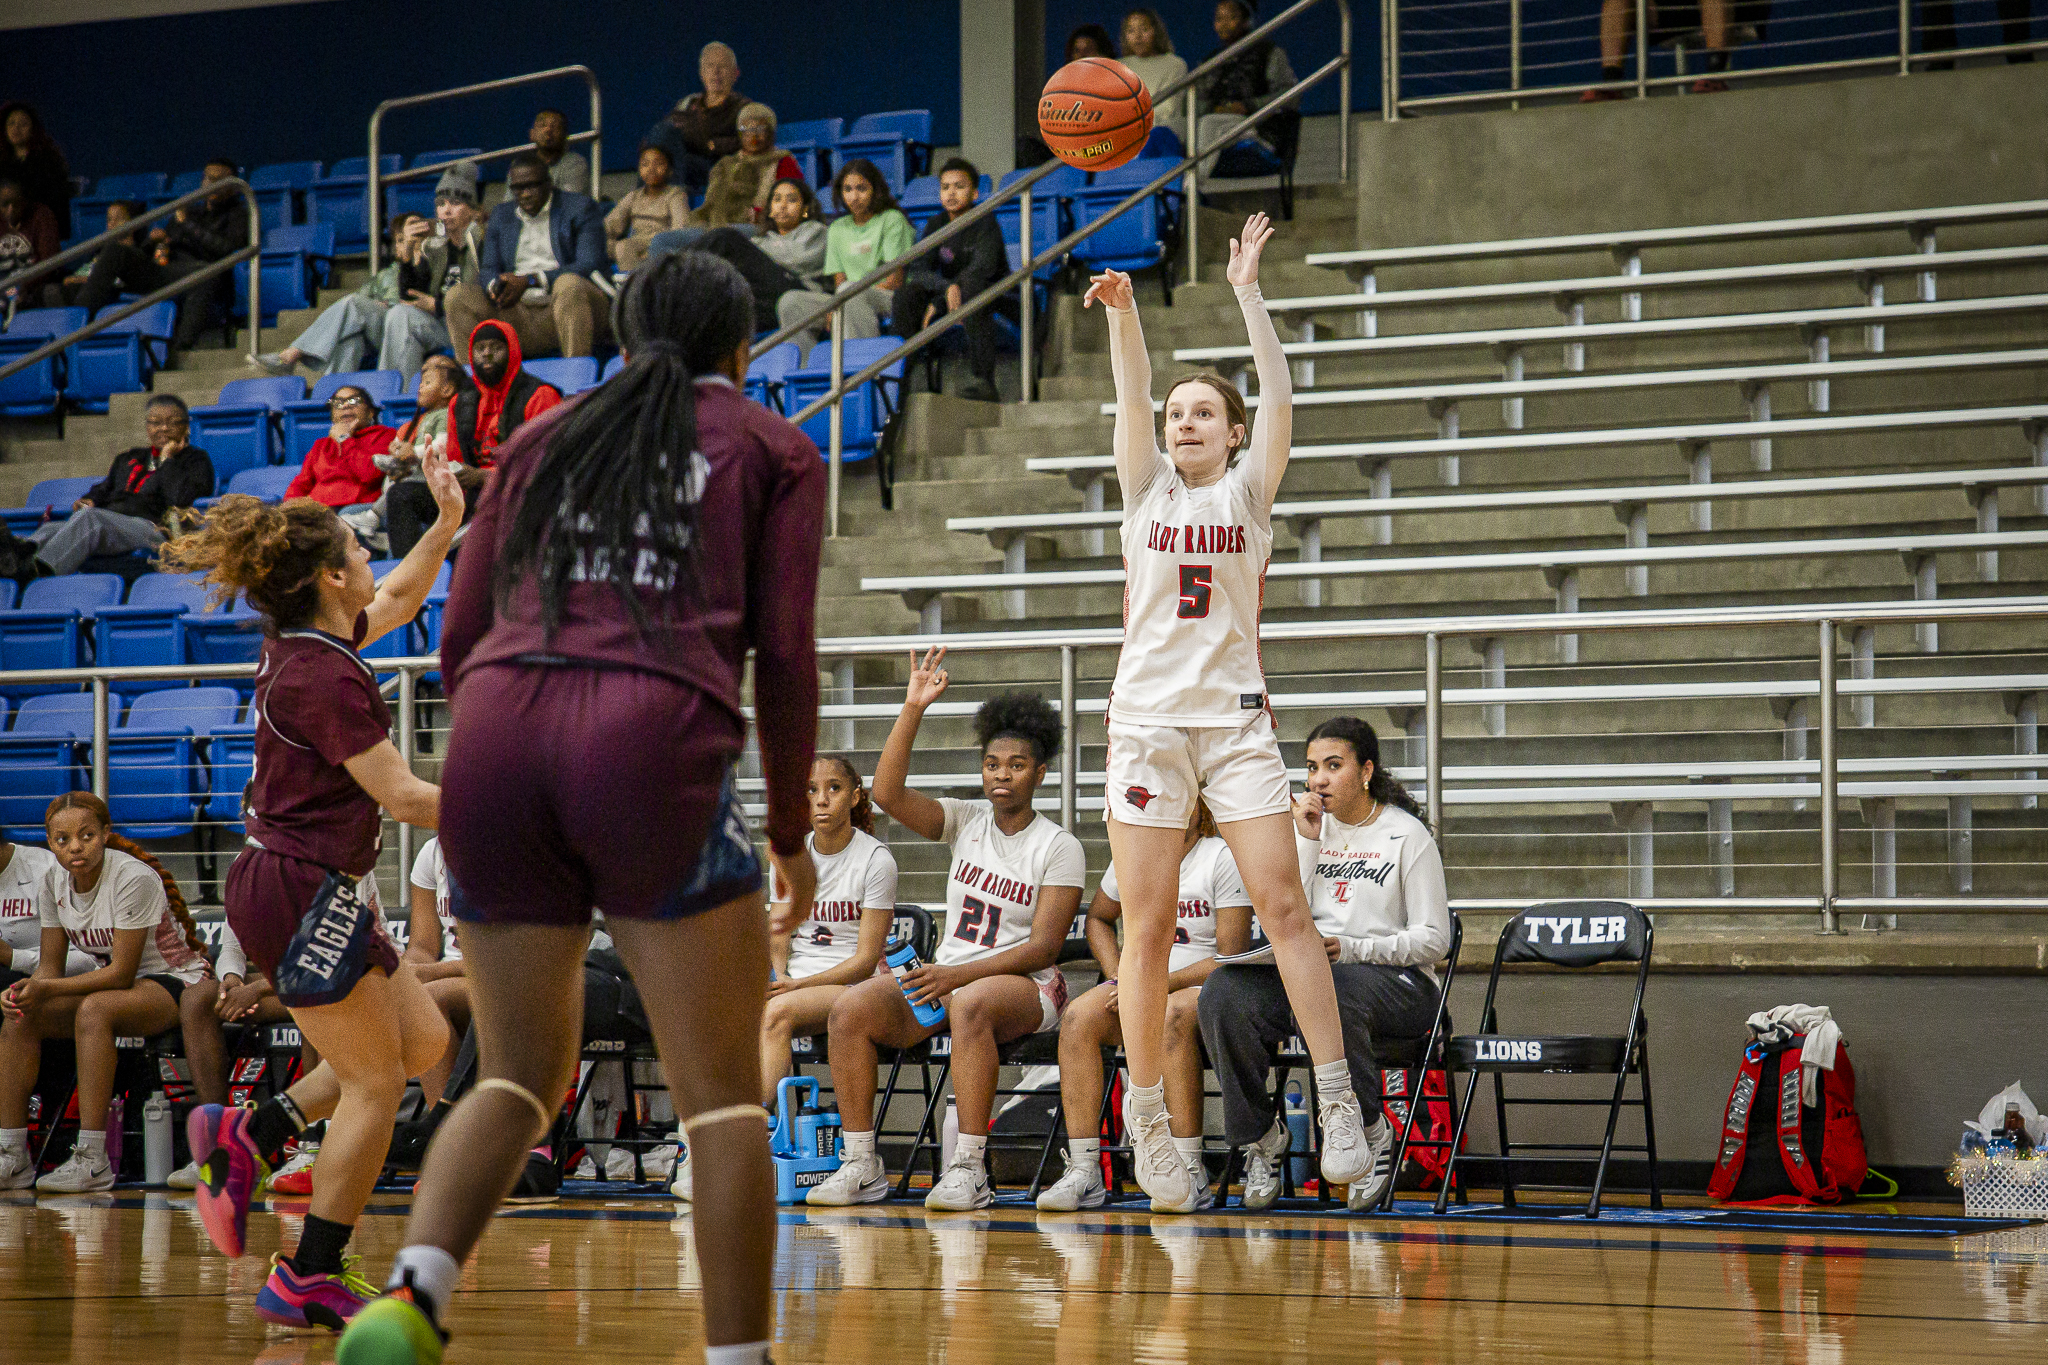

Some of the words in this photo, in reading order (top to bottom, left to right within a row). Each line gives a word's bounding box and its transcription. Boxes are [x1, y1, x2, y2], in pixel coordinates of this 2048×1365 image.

[1040, 100, 1103, 122] Baden
[1086, 141, 1111, 157] PRO
[1184, 525, 1247, 553] RAIDERS
[1177, 564, 1213, 619] 5
[1319, 847, 1345, 859] LADY
[1347, 851, 1381, 859] RAIDER
[954, 859, 984, 888] LADY
[981, 872, 1034, 907] RAIDERS
[1315, 859, 1396, 888] asketball
[2, 898, 34, 917] HELL
[813, 900, 862, 922] RAIDERS
[953, 894, 1003, 949] 21
[1523, 915, 1628, 945] TYLER
[1475, 1040, 1542, 1062] LIONS
